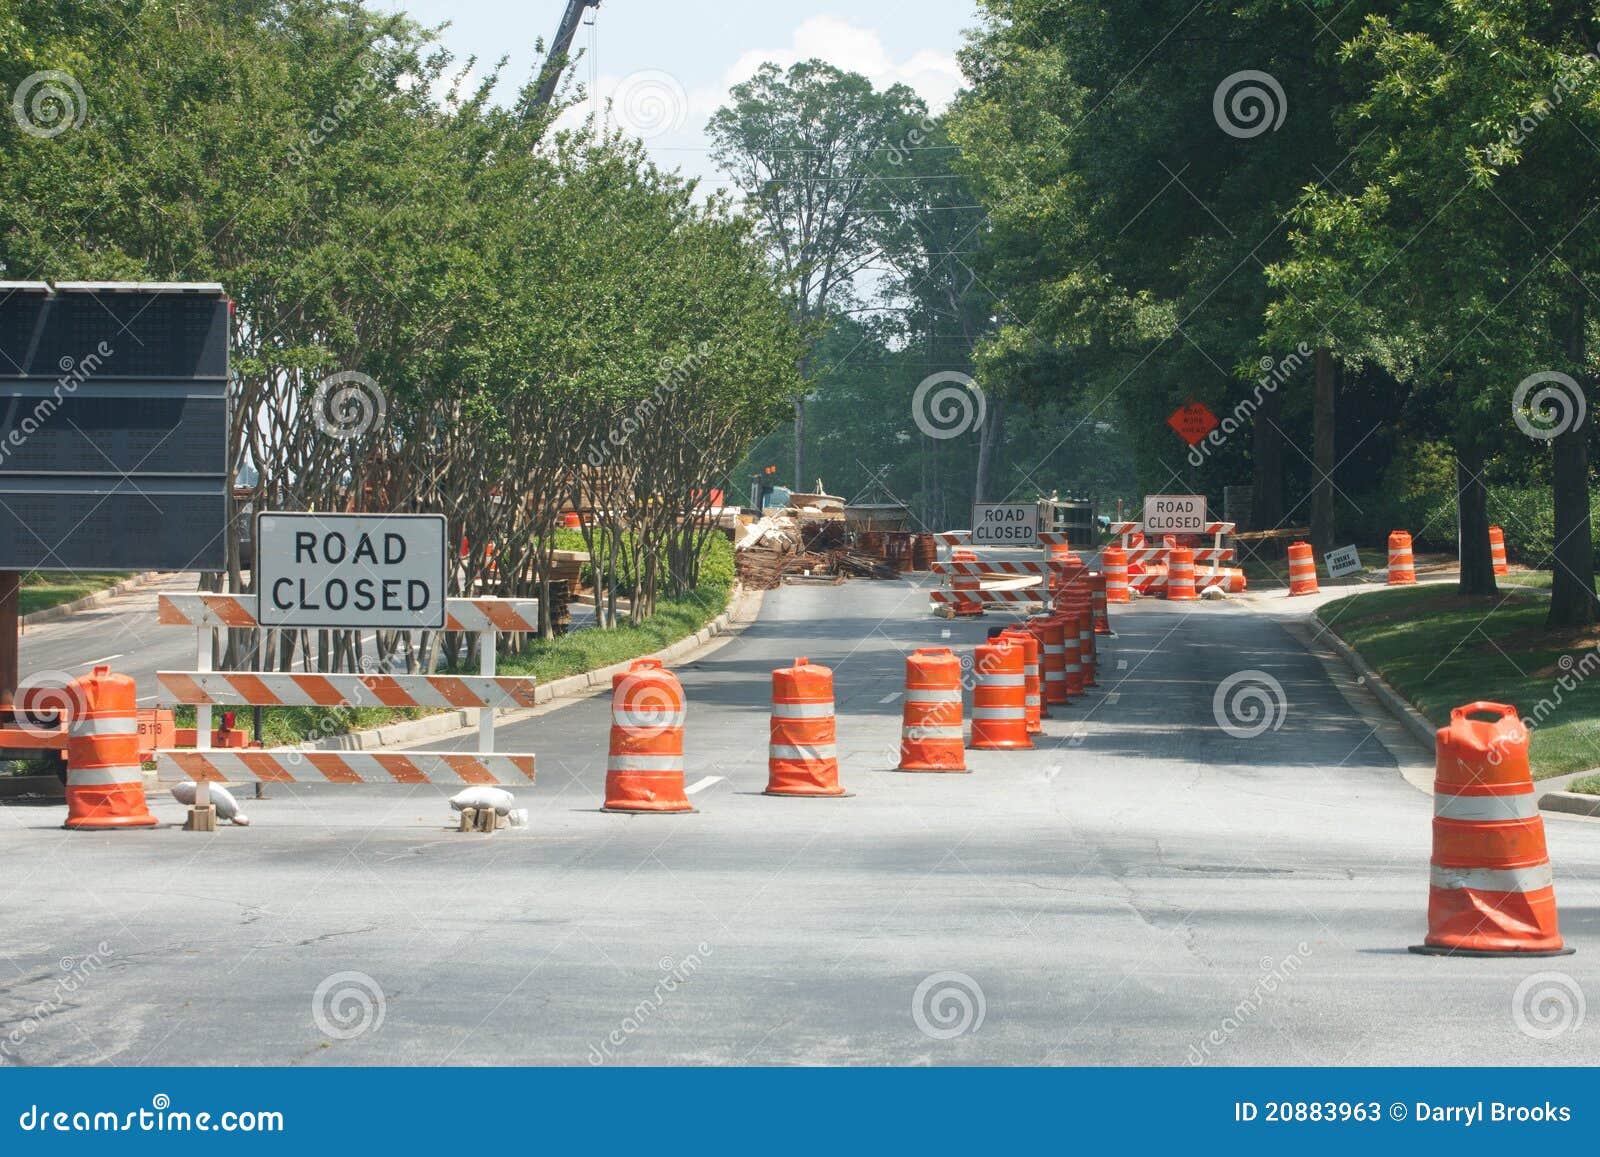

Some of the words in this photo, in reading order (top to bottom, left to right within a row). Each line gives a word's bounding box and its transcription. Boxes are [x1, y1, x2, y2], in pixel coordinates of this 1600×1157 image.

[1156, 501, 1194, 513] ROAD
[984, 509, 1025, 522] ROAD
[1149, 516, 1201, 529] CLOSED
[976, 526, 1033, 540] CLOSED
[295, 531, 407, 565] ROAD
[272, 577, 430, 612] CLOSED
